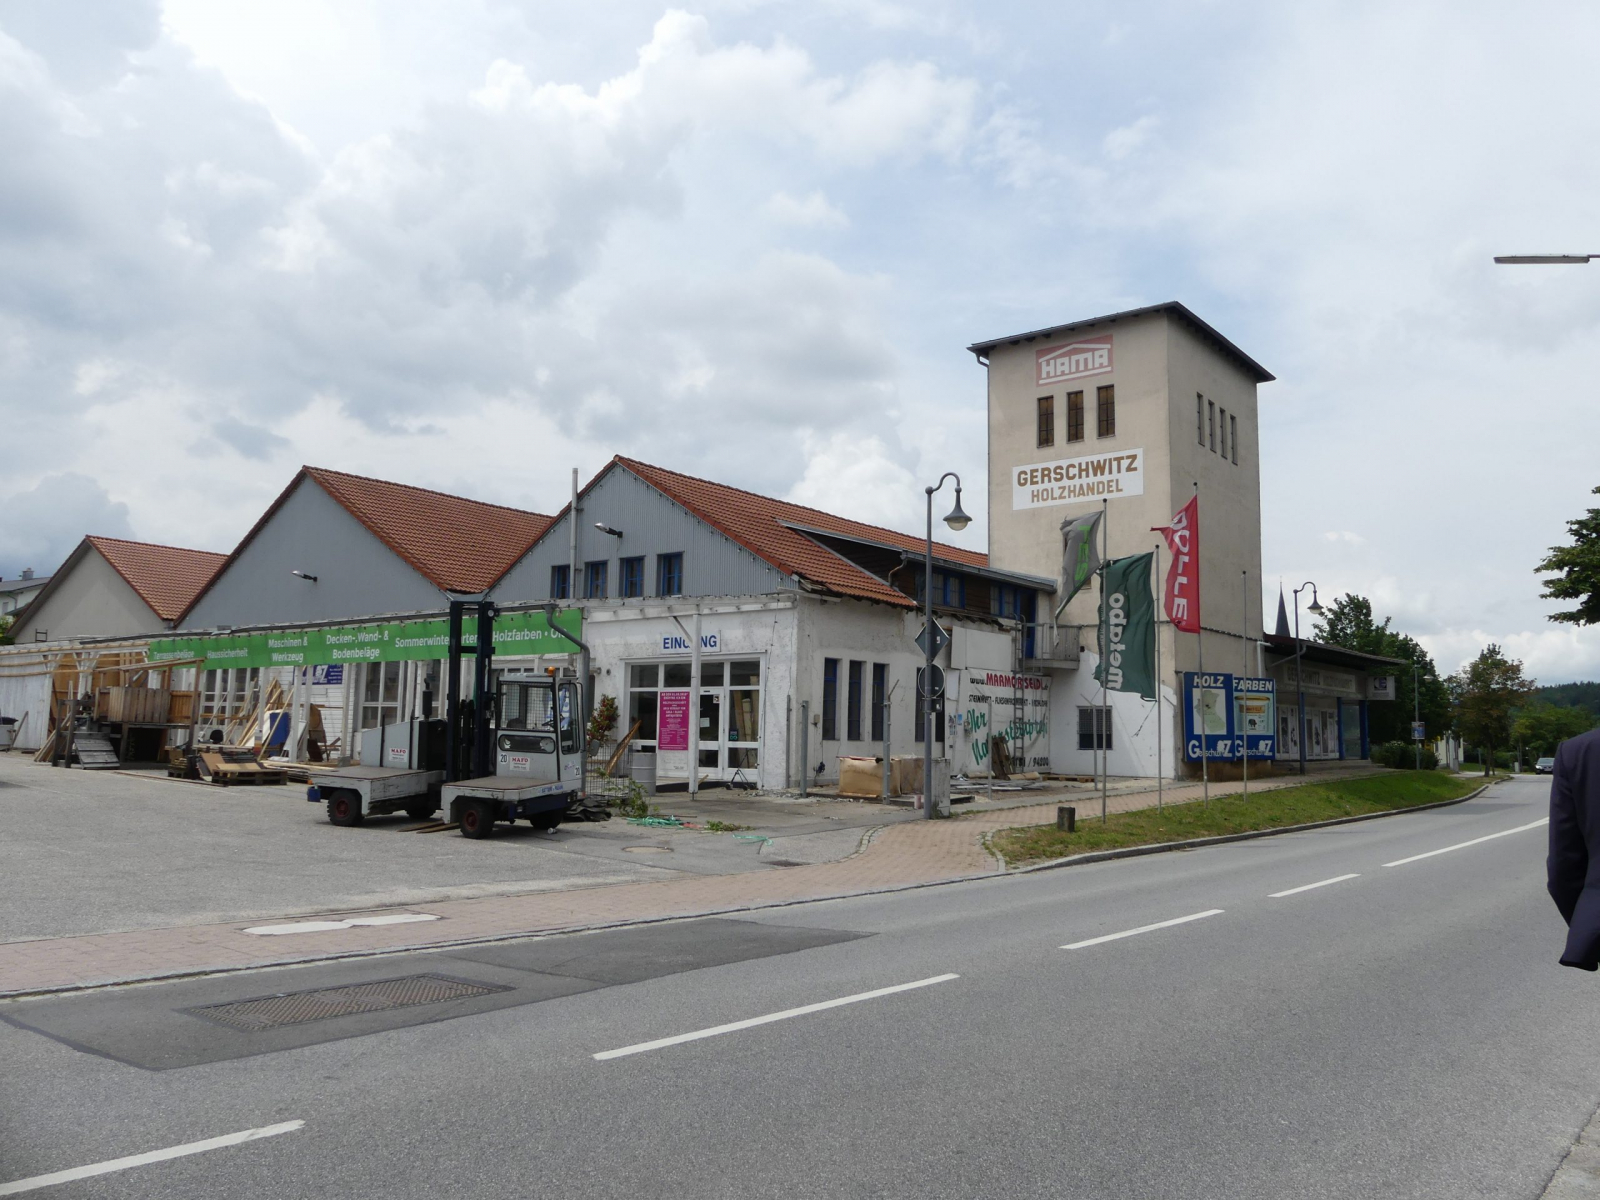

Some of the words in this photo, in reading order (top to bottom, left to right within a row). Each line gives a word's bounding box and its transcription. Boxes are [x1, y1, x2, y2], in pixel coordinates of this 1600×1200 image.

[1041, 348, 1109, 379] HAMA
[1017, 453, 1138, 487] GERSCHWITZ
[1031, 478, 1123, 503] HOLZHANDEL
[1169, 511, 1190, 620] DOLLE
[383, 630, 389, 641] &
[492, 630, 542, 642] Holzfarben
[268, 638, 302, 649] Maschinen
[302, 637, 308, 646] &
[663, 634, 717, 650] EINGNG
[153, 649, 195, 661] Terrassenbeläge
[207, 647, 248, 660] Haussicherheit
[272, 651, 304, 663] Werkzeug
[332, 647, 380, 660] Bodenbeläge
[1193, 675, 1224, 687] HOLZ
[1233, 679, 1273, 691] FARBEN
[500, 754, 508, 763] 20
